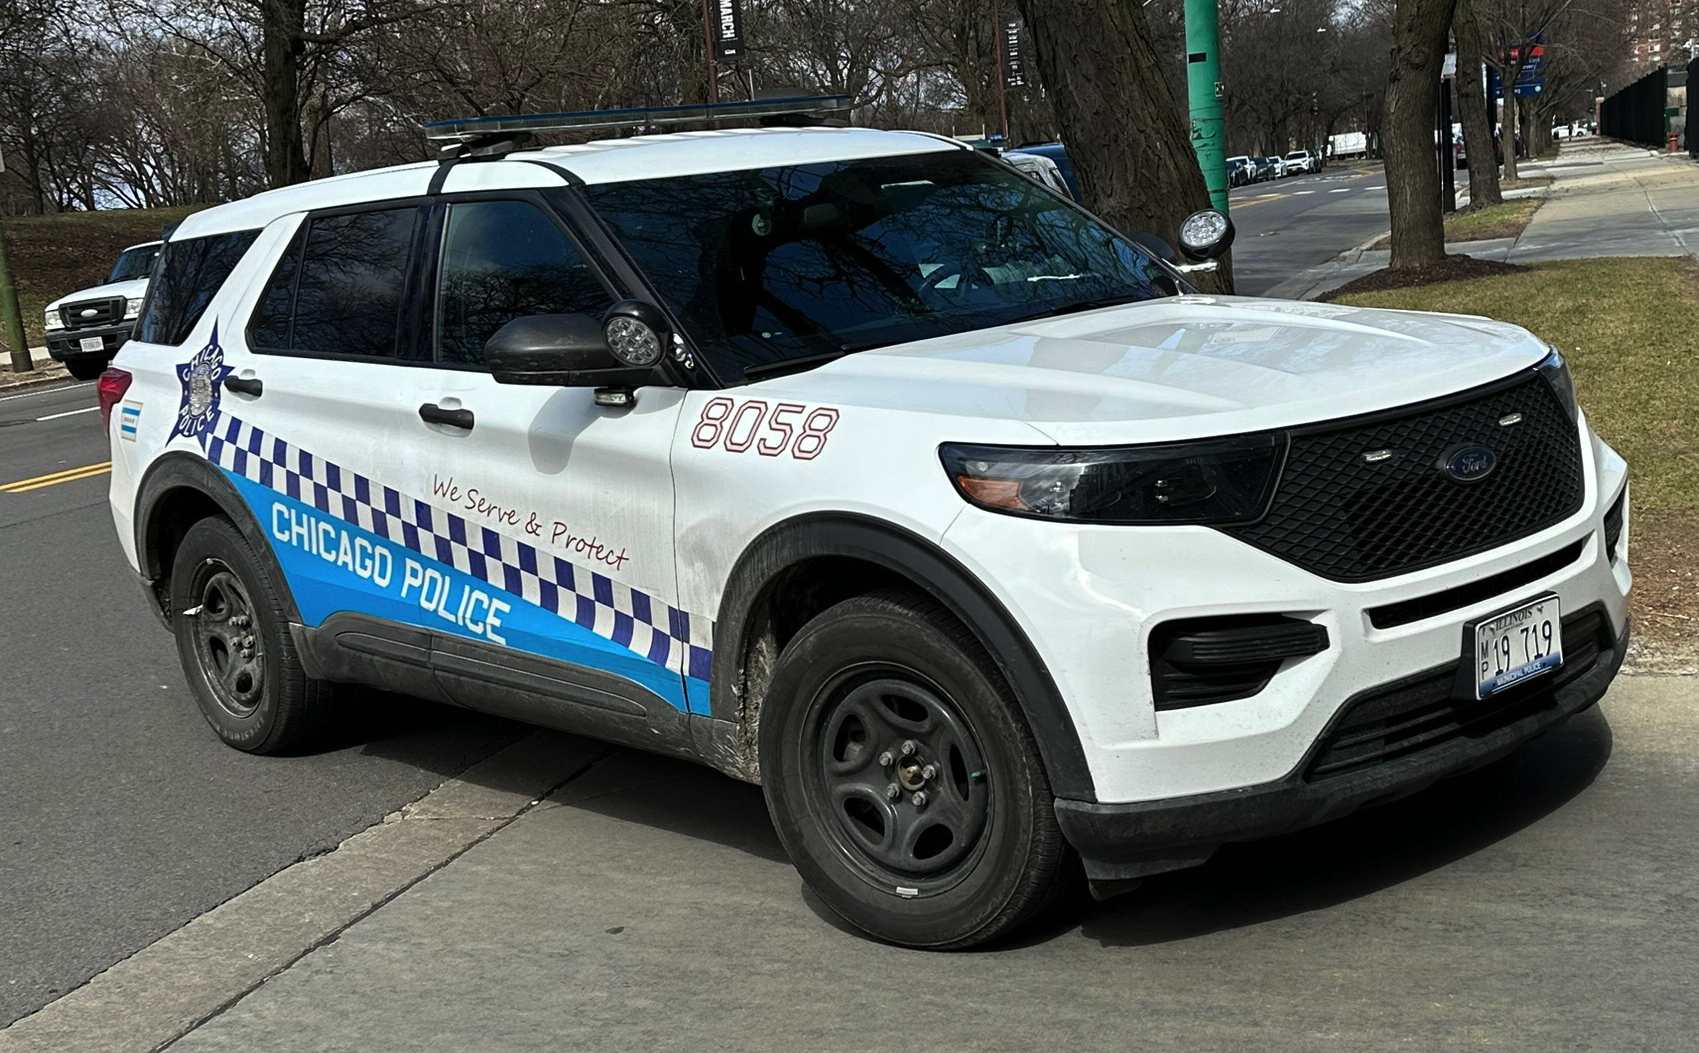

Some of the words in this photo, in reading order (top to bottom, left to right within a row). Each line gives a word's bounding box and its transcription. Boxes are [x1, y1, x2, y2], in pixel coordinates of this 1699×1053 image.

[719, 0, 735, 38] MARCH
[182, 344, 222, 382] CHICAGO
[179, 404, 215, 435] POLICE
[691, 396, 840, 460] 8058
[1462, 453, 1487, 474] Ford
[432, 473, 462, 502] We
[464, 488, 520, 526] Serve
[525, 511, 542, 537] &
[551, 521, 630, 571] Protect
[272, 501, 393, 588] CHICAGO
[400, 557, 512, 646] POLICE
[1494, 608, 1532, 631] ILLINOIS
[1493, 635, 1510, 676] 19
[1520, 620, 1552, 663] 719
